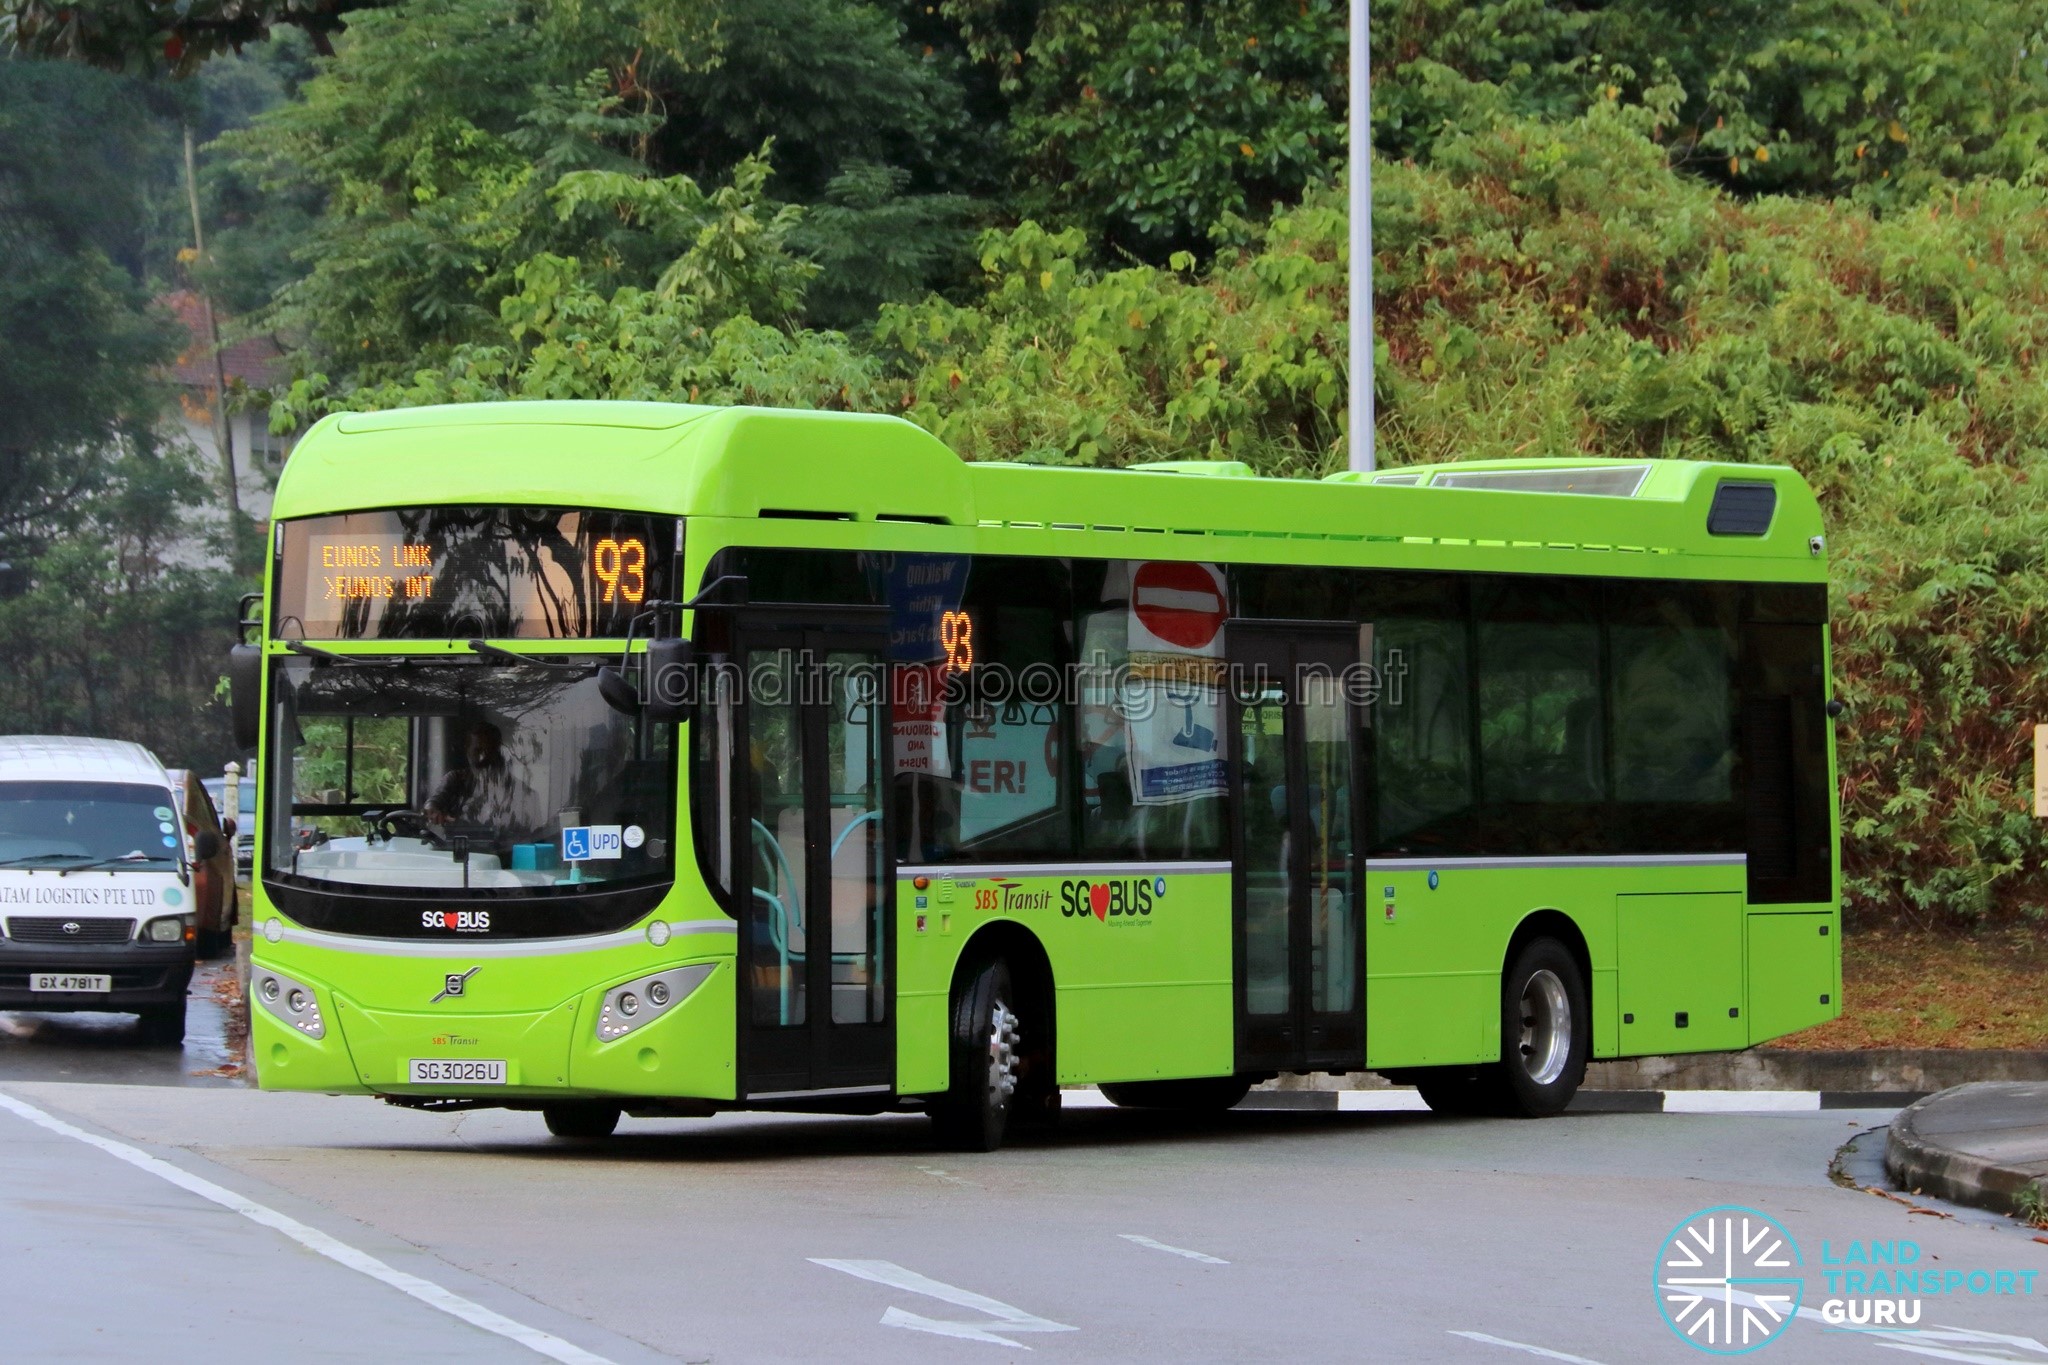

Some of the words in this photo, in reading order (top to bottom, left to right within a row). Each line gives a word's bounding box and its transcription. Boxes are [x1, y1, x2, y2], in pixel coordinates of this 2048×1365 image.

[322, 545, 381, 568] EUNOS
[393, 545, 432, 568] LINK
[594, 539, 646, 602] 93
[405, 576, 434, 599] INT
[941, 610, 973, 673] 93
[593, 833, 620, 850] UPD
[0, 886, 31, 904] TAM
[36, 887, 99, 905] LOGISTICS
[104, 887, 127, 905] PTE
[133, 888, 156, 906] LTD
[975, 889, 999, 911] SBS
[997, 883, 1053, 914] Transit
[432, 1037, 447, 1045] SBS
[447, 1034, 479, 1046] Transit
[417, 1063, 499, 1080] SG3026U
